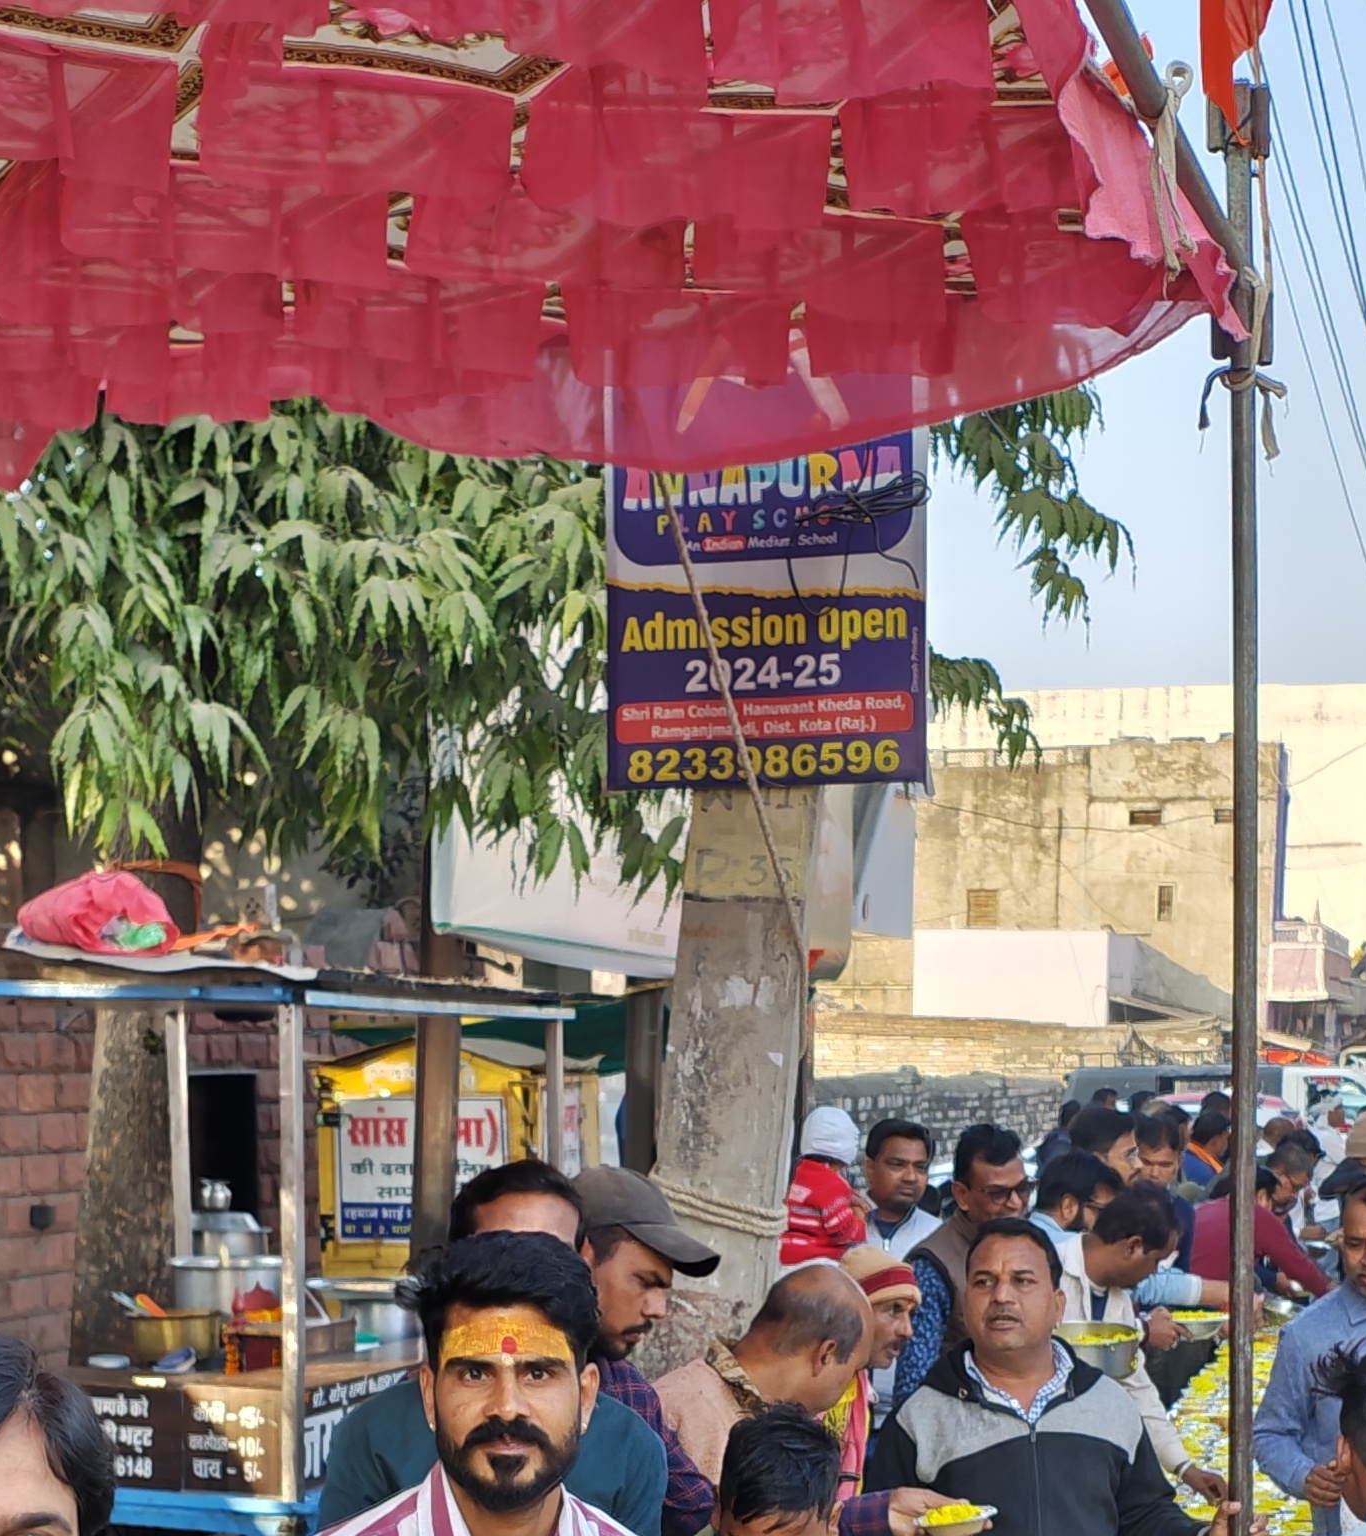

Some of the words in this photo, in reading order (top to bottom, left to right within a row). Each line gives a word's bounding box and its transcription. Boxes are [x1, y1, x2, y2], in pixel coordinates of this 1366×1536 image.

[704, 537, 744, 551] Indian
[797, 531, 838, 546] School
[819, 605, 908, 650] Open
[685, 652, 842, 693] 2024-25
[622, 706, 650, 722] Shri
[653, 704, 685, 719] Ram
[817, 697, 863, 713] Kheda
[865, 695, 907, 711] Road,
[651, 722, 760, 741] Ramganjmadi,
[763, 720, 795, 734] Dist.
[799, 718, 832, 733] Kota
[835, 715, 877, 734] (Raj.)
[627, 739, 900, 783] 8233986596
[348, 1105, 408, 1147] सांस
[350, 1157, 374, 1176] की
[192, 1457, 223, 1479] चाय
[243, 1460, 263, 1483] 5/-
